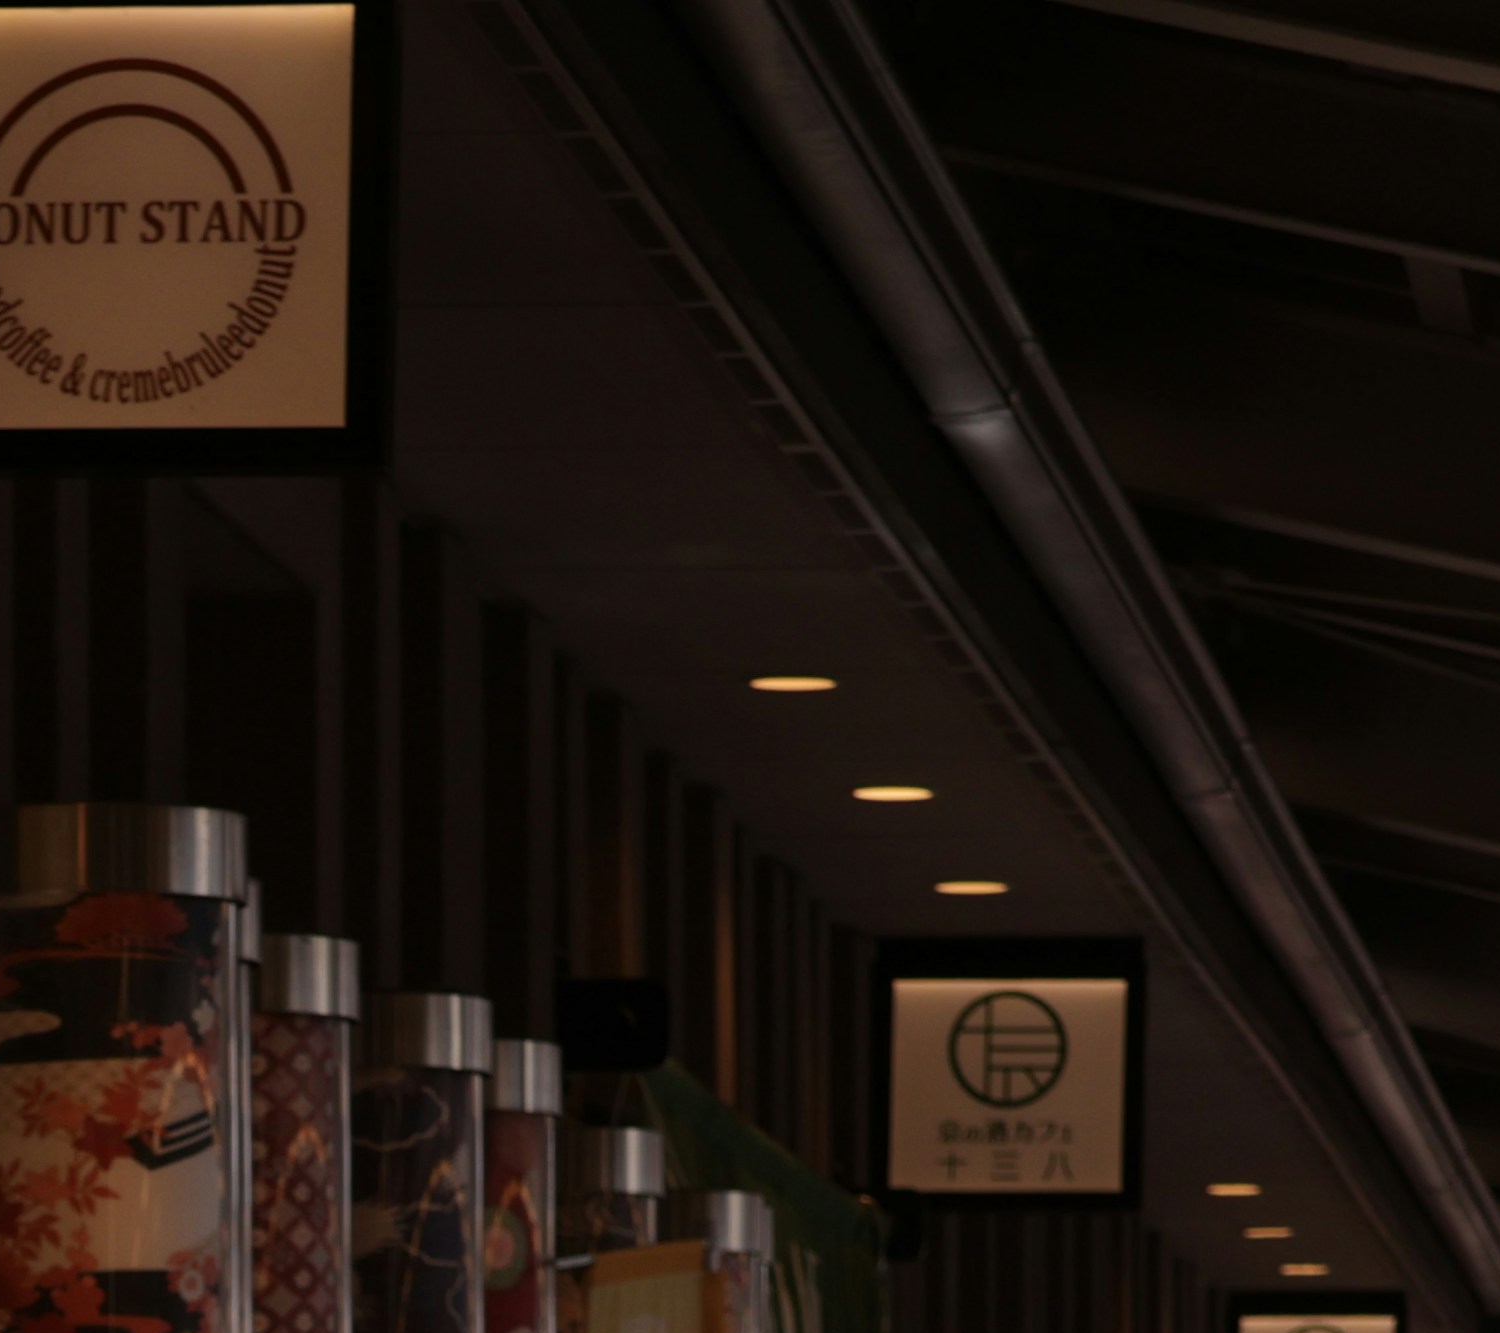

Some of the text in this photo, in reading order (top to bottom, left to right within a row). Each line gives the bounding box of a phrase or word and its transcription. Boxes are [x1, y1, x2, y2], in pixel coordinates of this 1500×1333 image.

[139, 199, 306, 244] STAND
[59, 353, 87, 397] &
[90, 243, 297, 403] cremebruleedonut
